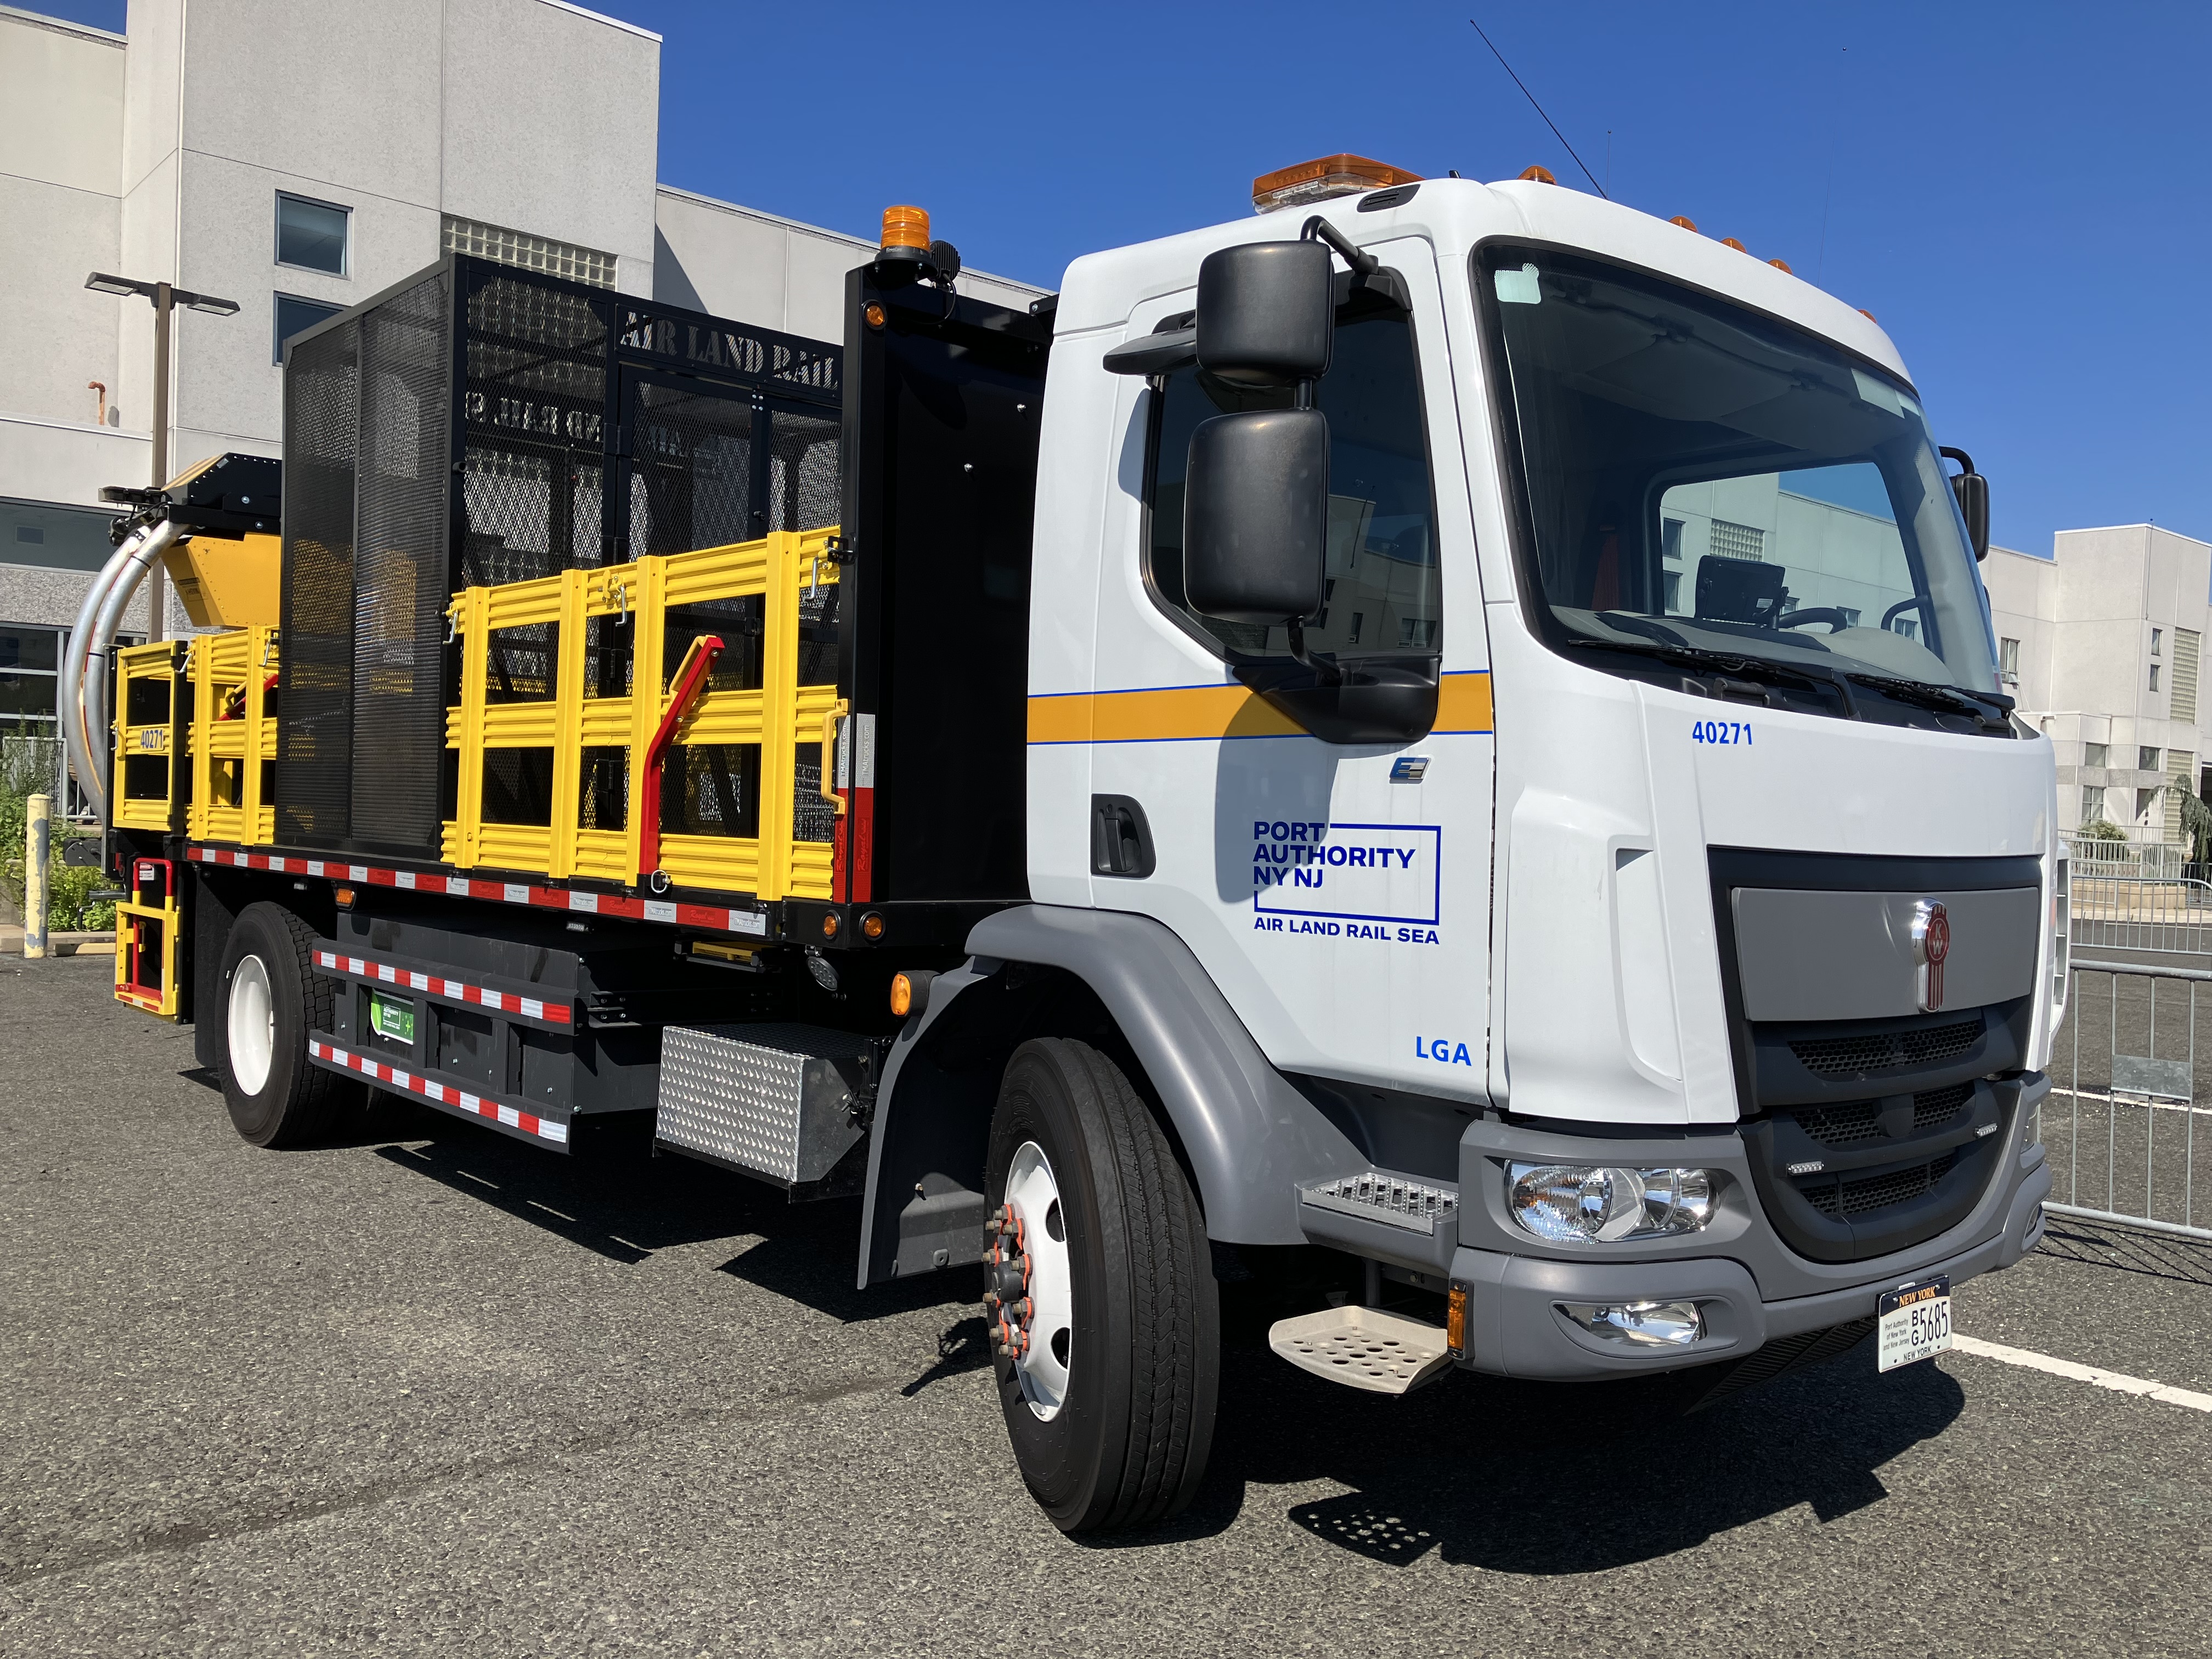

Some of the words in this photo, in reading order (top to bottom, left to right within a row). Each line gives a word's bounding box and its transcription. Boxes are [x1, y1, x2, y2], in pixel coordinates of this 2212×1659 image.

[620, 311, 677, 356] AIR
[686, 325, 764, 374] LAND
[772, 345, 838, 390] RAIL
[140, 729, 163, 749] 40271
[1692, 721, 1752, 745] 40271
[1254, 821, 1325, 843] PORT
[857, 834, 867, 871] Royal
[1253, 844, 1416, 869] AUTHORITY
[1254, 866, 1287, 886] NY
[1295, 868, 1323, 888] NJ
[1254, 917, 1283, 933] AIR
[1289, 919, 1340, 936] LAND
[1346, 923, 1391, 941] RAIL
[1397, 928, 1440, 944] SEA
[1417, 1036, 1472, 1066] LGA
[1899, 1291, 1917, 1307] NEW
[1917, 1286, 1936, 1300] YORK
[1904, 1351, 1915, 1362] NEW
[1917, 1345, 1932, 1357] YORK
